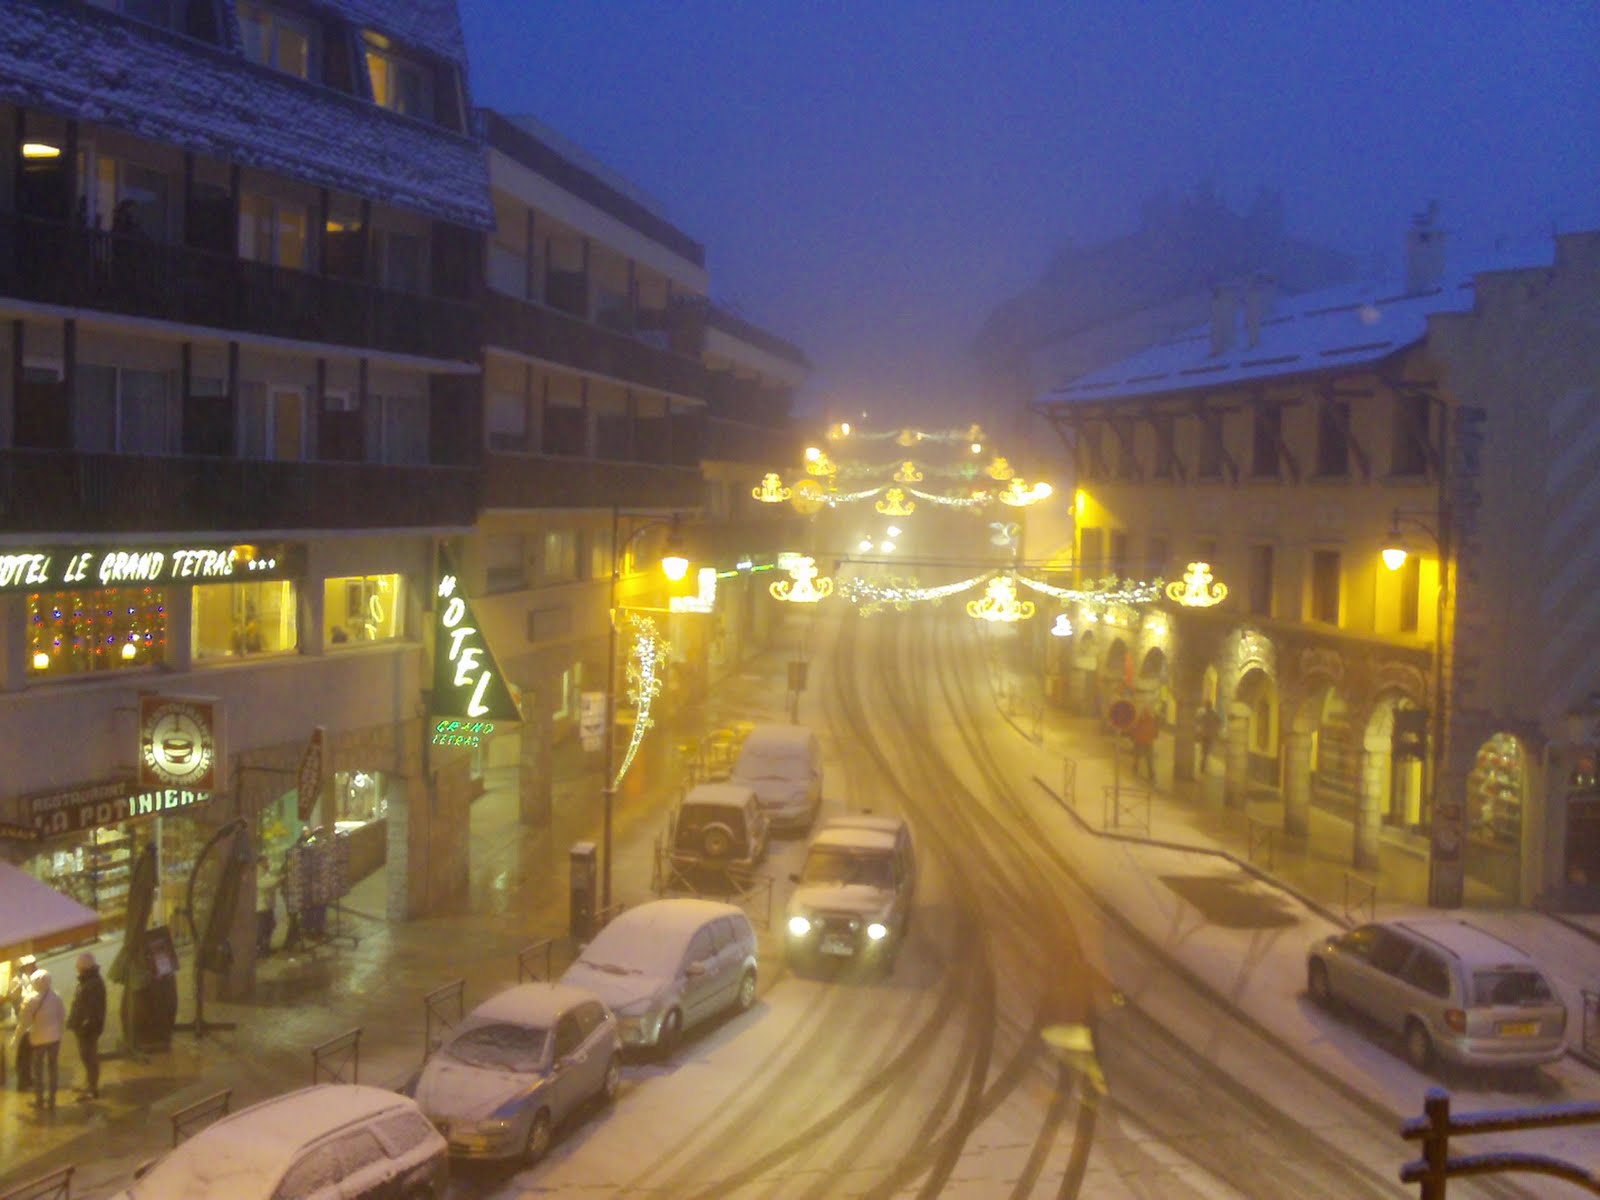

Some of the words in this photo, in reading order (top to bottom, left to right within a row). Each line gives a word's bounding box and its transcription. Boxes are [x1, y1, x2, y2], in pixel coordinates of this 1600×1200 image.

[63, 552, 94, 583] LE
[99, 551, 165, 585] GRAND
[171, 549, 238, 578] TETRAS
[438, 575, 492, 717] HOTEL
[436, 720, 494, 734] GRAND
